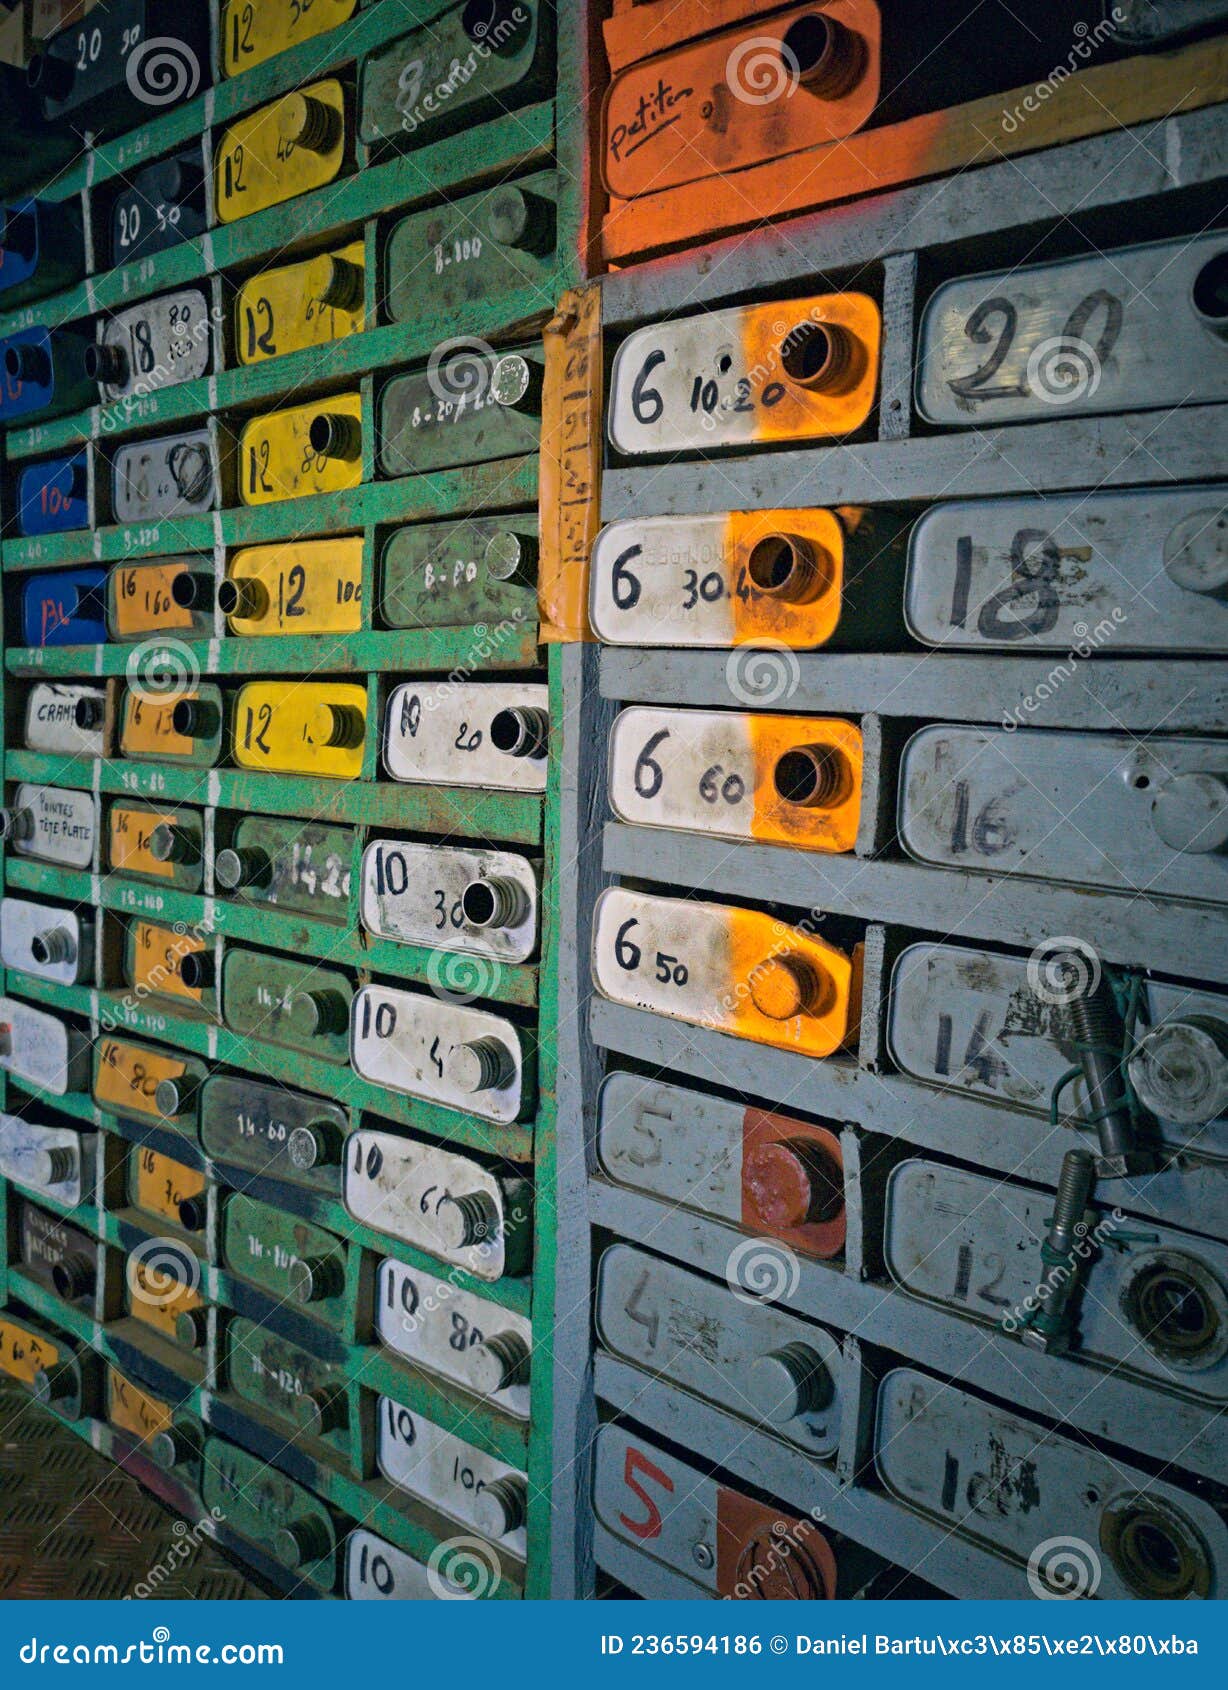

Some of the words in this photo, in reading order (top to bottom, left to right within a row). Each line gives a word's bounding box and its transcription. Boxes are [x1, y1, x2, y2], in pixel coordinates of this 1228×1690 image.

[77, 28, 102, 71] 20
[232, 2, 254, 63] 12
[225, 145, 249, 200] 12
[119, 204, 141, 247] 20
[129, 319, 156, 377] 18
[246, 297, 277, 358] 12
[631, 349, 666, 425] 6
[249, 439, 274, 495] 12
[121, 569, 137, 600] 16
[277, 564, 307, 628] 12
[612, 543, 643, 610] 6
[948, 526, 1062, 642] 18
[243, 703, 272, 756] 12
[454, 721, 483, 753] 20
[633, 726, 671, 800] 6
[699, 763, 746, 806] 60
[374, 846, 409, 896] 10
[614, 917, 642, 972] 6
[655, 950, 689, 988] 50
[362, 993, 398, 1040] 10
[355, 1138, 384, 1181] 10
[386, 1268, 420, 1315] 10
[388, 1399, 417, 1447] 10
[360, 1544, 395, 1595] 10
